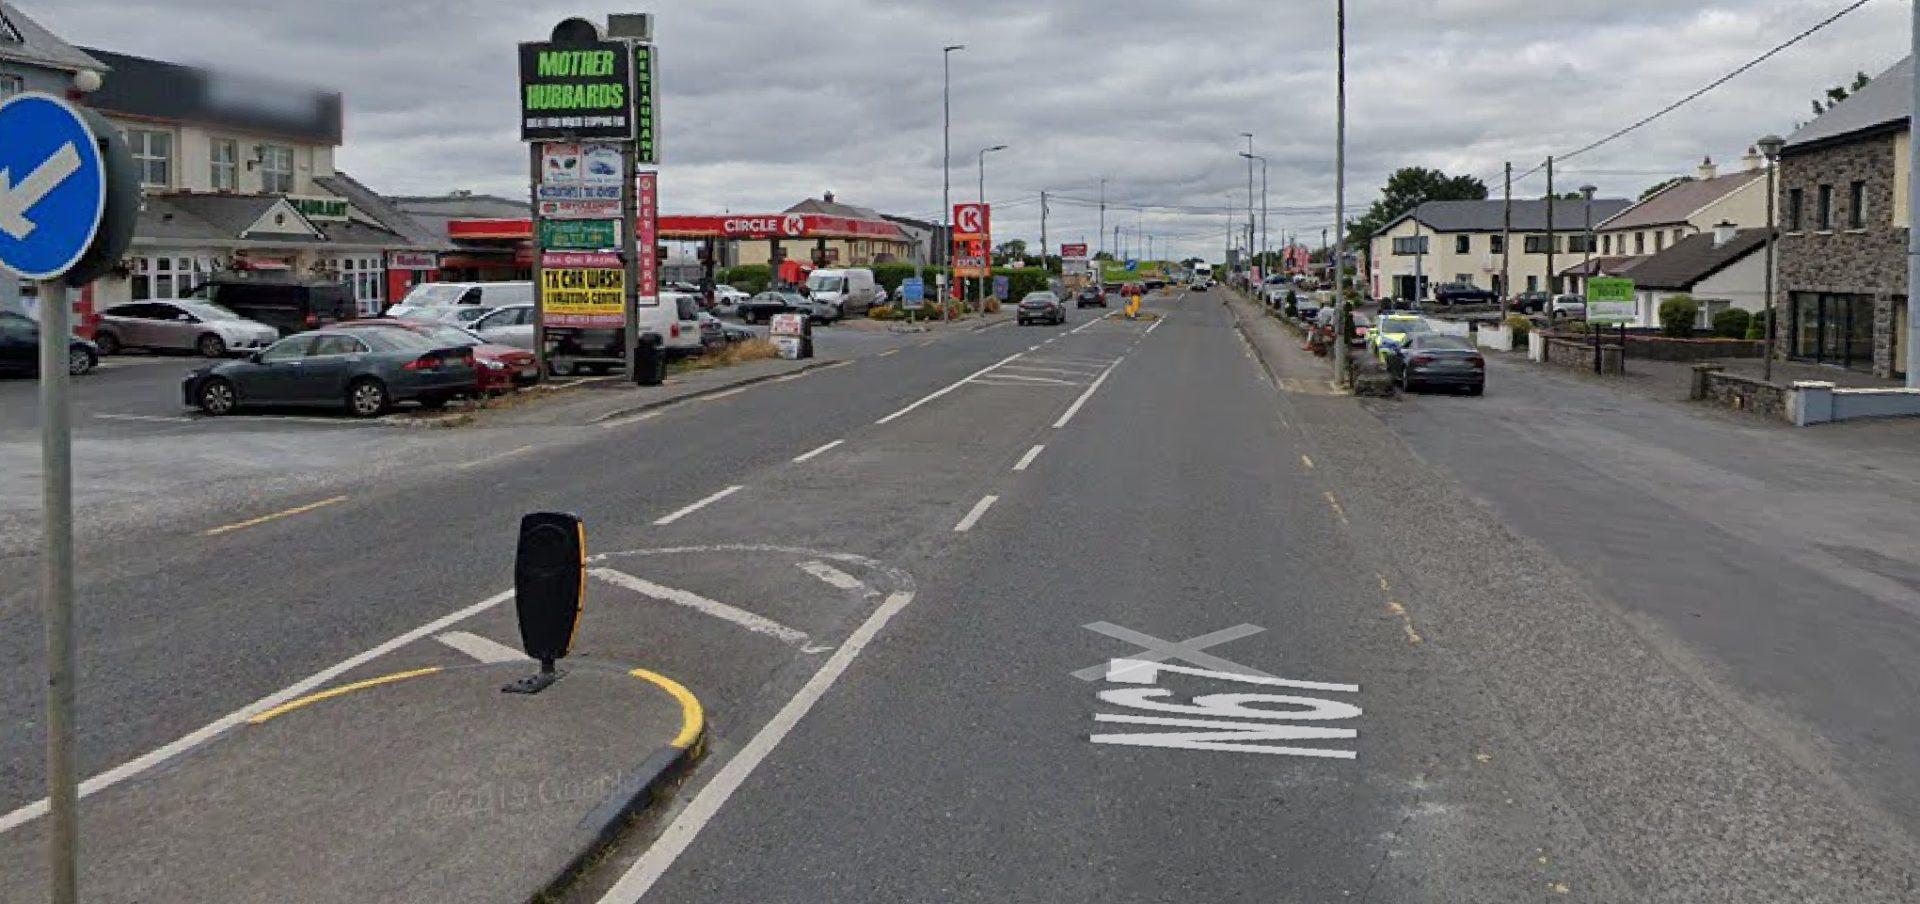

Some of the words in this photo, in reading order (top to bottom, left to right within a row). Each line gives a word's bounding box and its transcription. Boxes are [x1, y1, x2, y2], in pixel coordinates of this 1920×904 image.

[538, 51, 615, 77] MOTHER
[526, 84, 624, 109] HUBBARDS
[725, 219, 777, 233] CIRCLE
[562, 270, 585, 289] CAR
[587, 269, 622, 289] WASH
